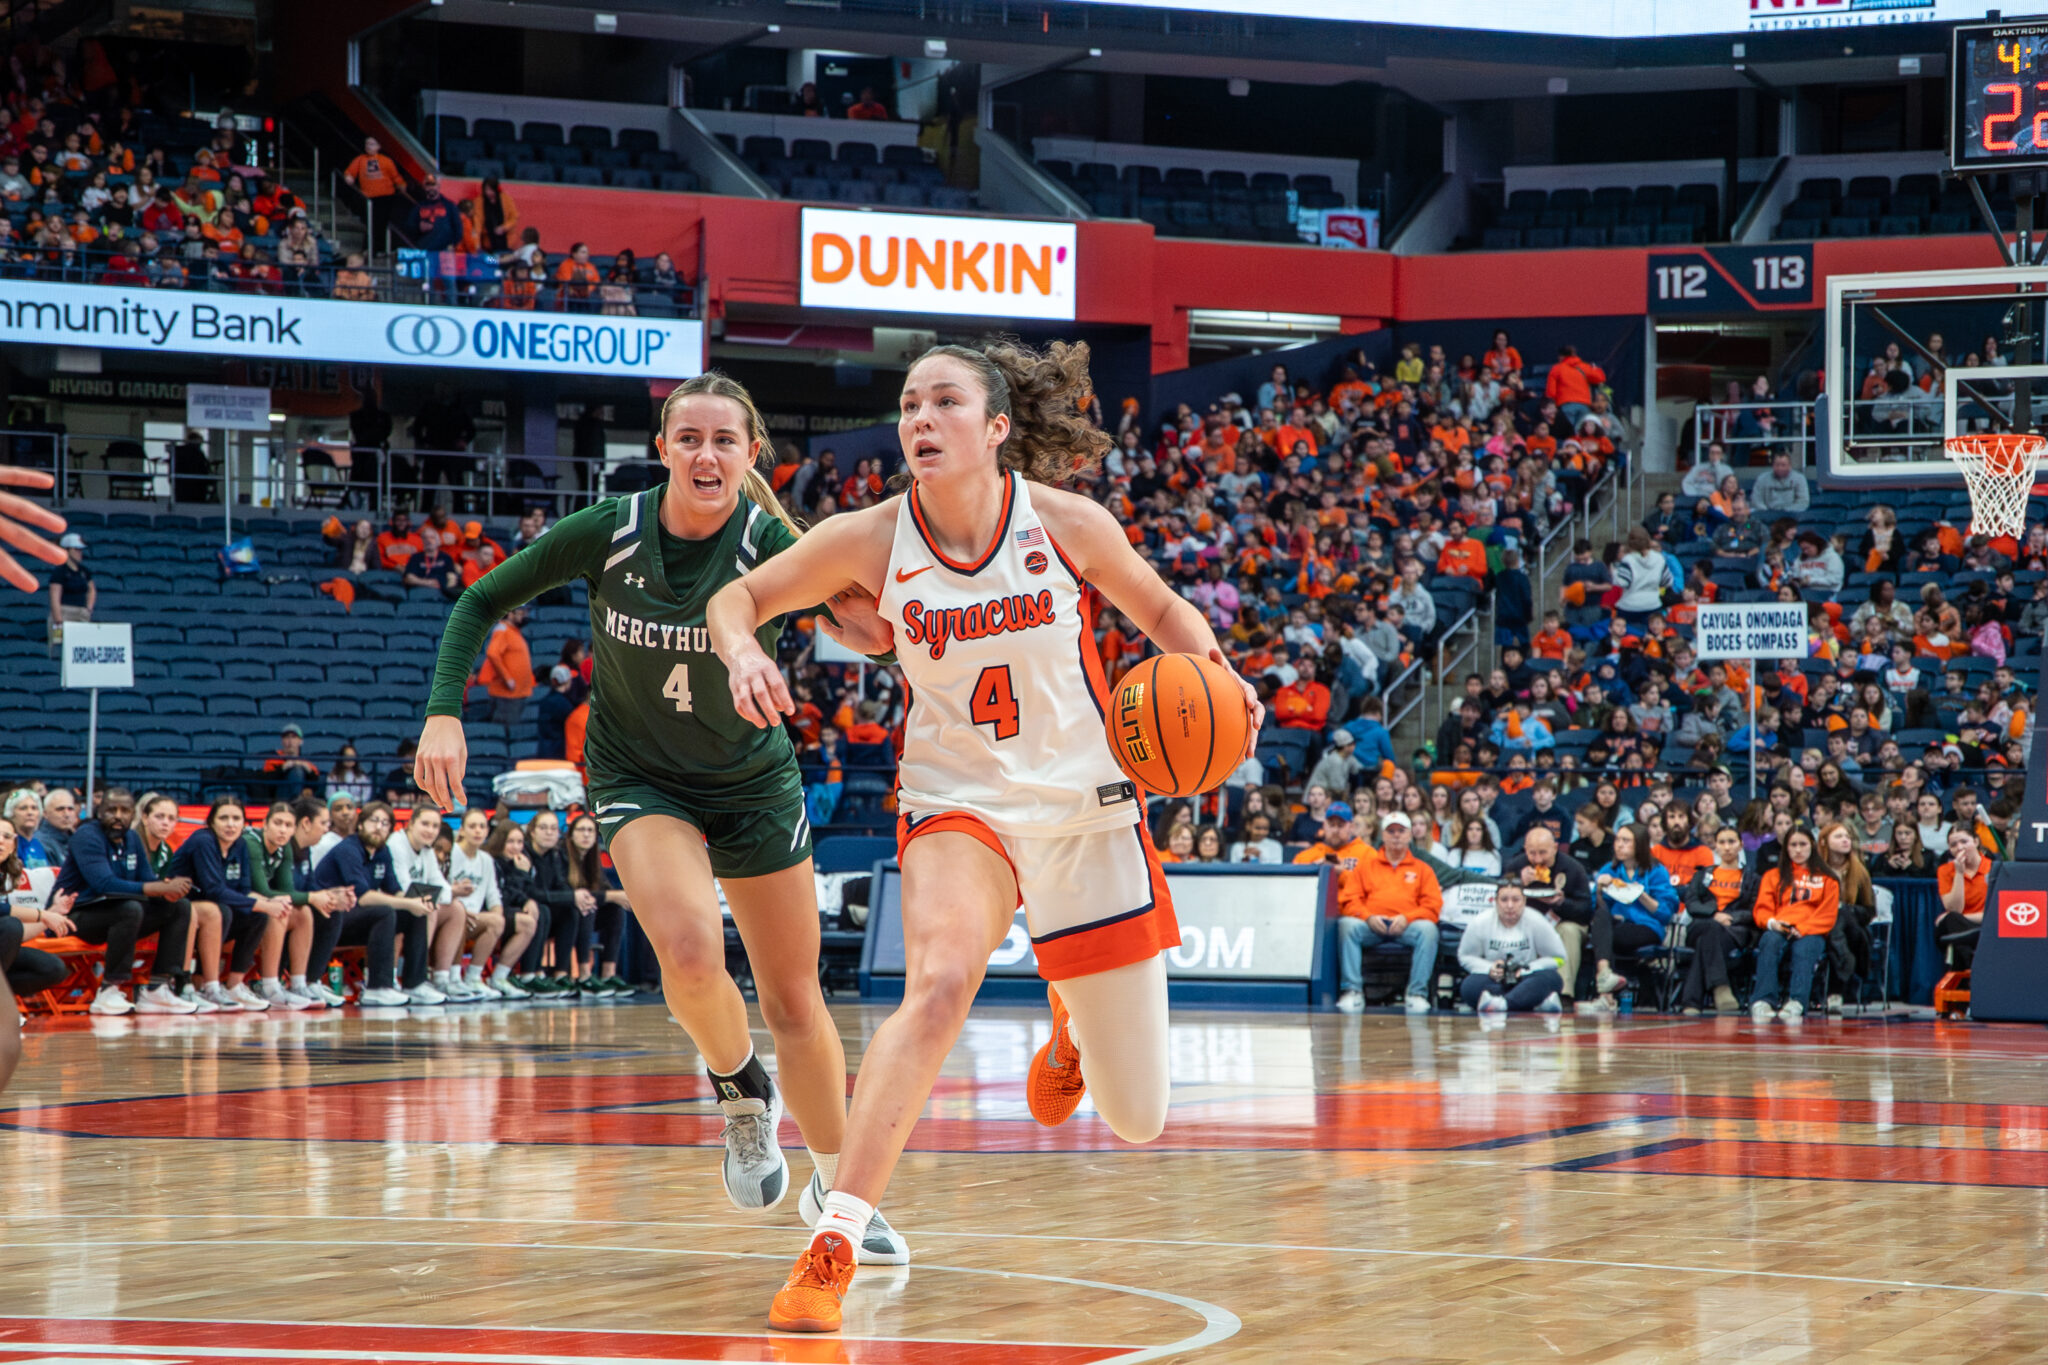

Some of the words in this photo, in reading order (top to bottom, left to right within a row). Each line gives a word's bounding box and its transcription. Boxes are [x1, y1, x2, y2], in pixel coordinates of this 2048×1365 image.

[1749, 14, 1862, 31] AUTOMOTIVE
[1878, 11, 1936, 25] GROUP
[811, 232, 1068, 296] DUNKIN'
[1655, 265, 1707, 299] 112
[1752, 255, 1805, 290] 113
[0, 297, 180, 346] munity
[191, 303, 303, 346] Bank
[472, 319, 666, 367] ONEGROUP
[605, 606, 716, 654] MERCYHU
[903, 588, 1056, 660] Syracuse
[1701, 612, 1742, 630] CAYUGA
[1746, 610, 1803, 629] ONONDAGA
[662, 663, 693, 713] 4
[969, 664, 1020, 742] 4
[1120, 683, 1151, 764] ELITE
